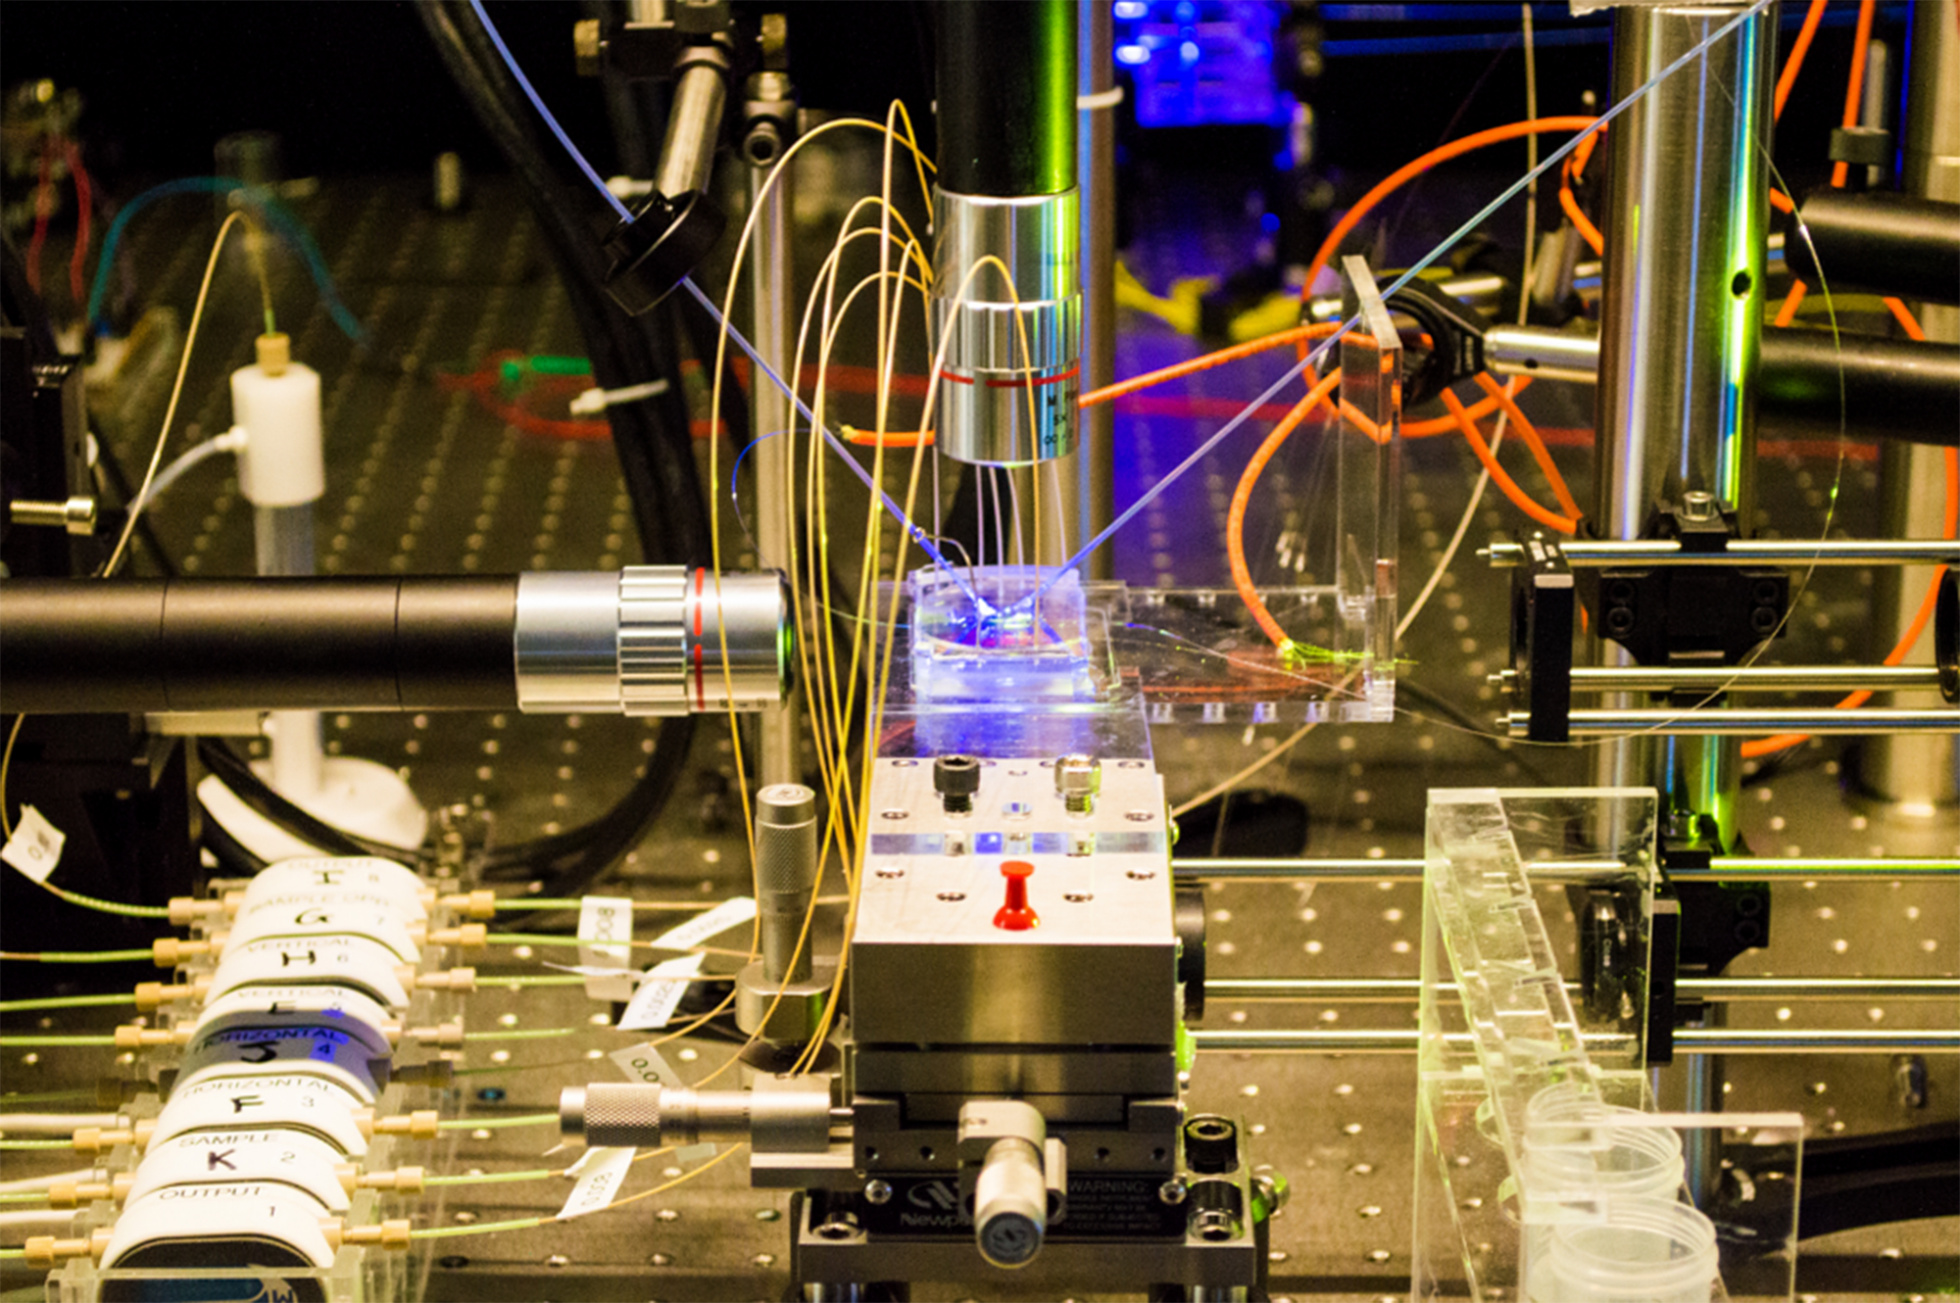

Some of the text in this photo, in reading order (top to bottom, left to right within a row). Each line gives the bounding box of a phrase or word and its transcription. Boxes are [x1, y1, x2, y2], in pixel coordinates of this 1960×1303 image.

[247, 938, 353, 952] VERTICAL
[237, 988, 347, 998] VERTICAL
[194, 1028, 343, 1054] HORIZONTAL
[316, 1043, 331, 1055] 4
[183, 1078, 335, 1098] HORIZONTAL
[231, 1095, 264, 1113] F
[302, 1096, 314, 1107] 3
[179, 1133, 278, 1148] SAMPLE
[208, 1149, 237, 1171] K
[281, 1152, 295, 1163] 2
[159, 1187, 266, 1200] OUTPUT
[269, 1206, 275, 1216] 1
